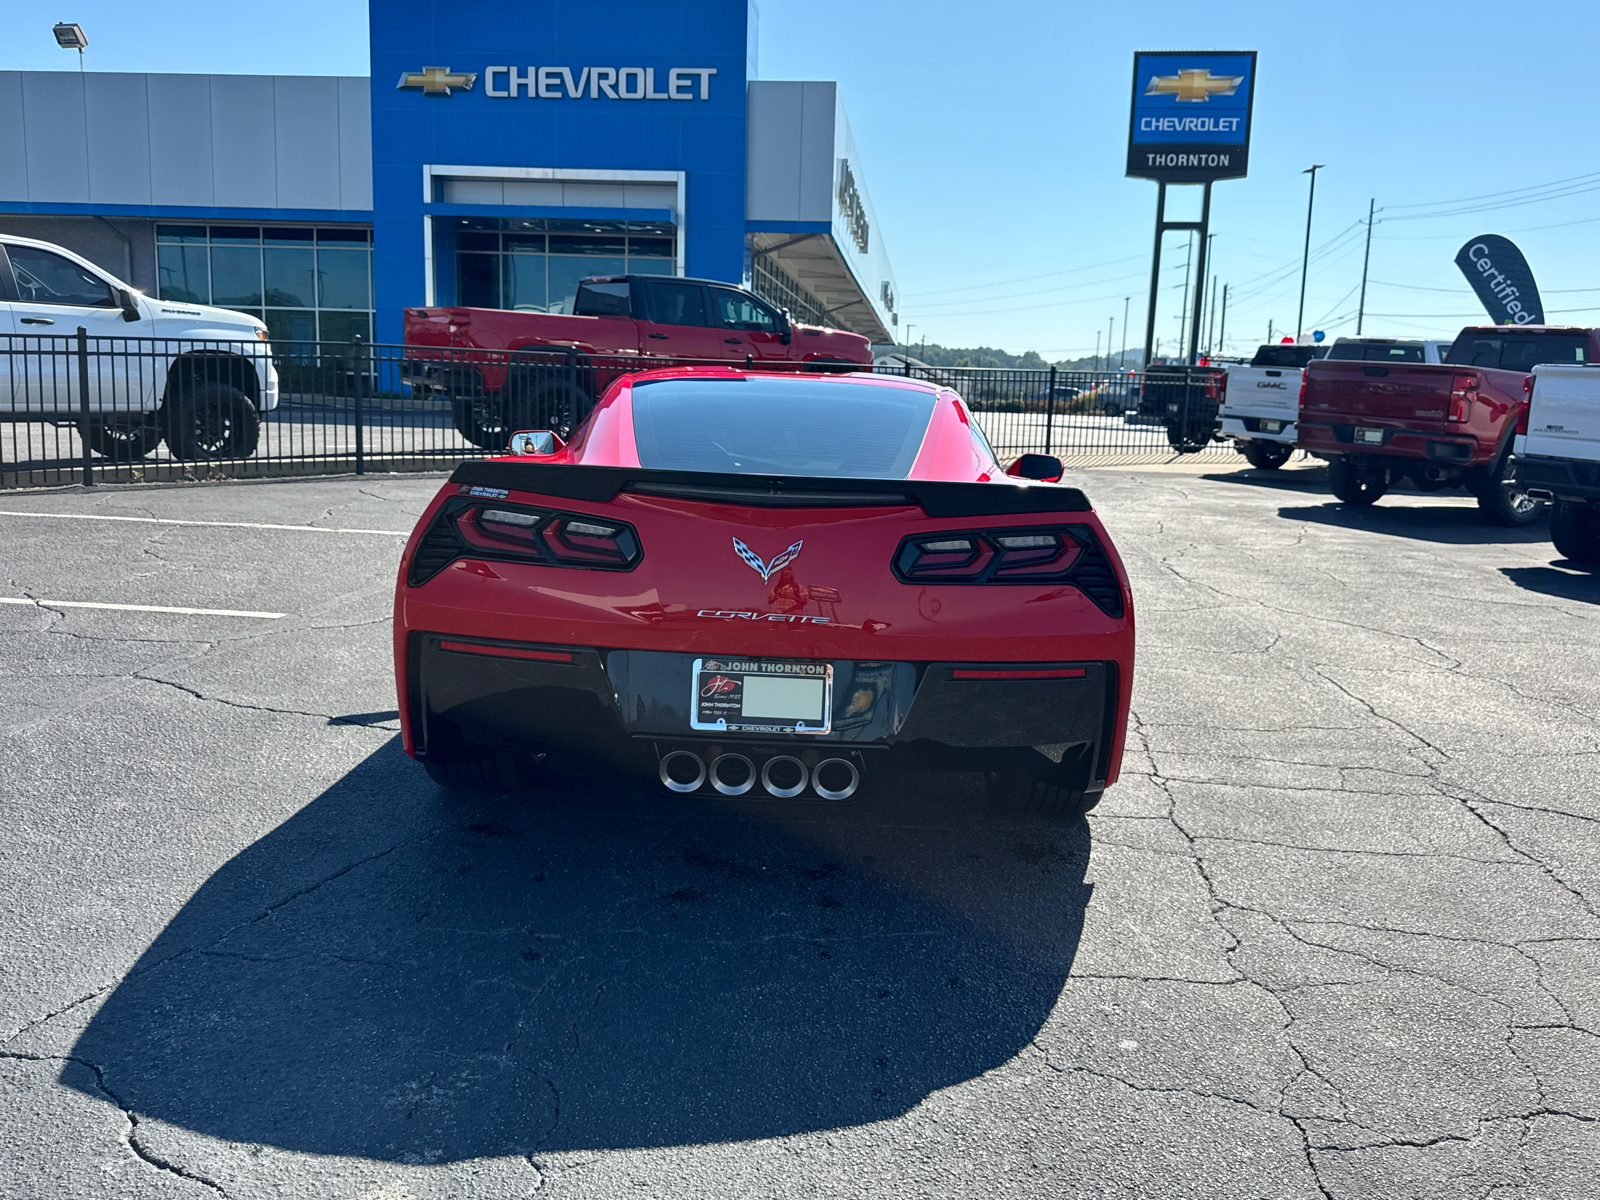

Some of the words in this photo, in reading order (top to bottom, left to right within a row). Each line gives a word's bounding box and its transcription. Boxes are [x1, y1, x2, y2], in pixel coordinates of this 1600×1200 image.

[485, 66, 717, 100] CHEVROLET
[1140, 117, 1240, 132] CHEVROLET
[1147, 153, 1230, 167] THORNTON
[1468, 243, 1536, 325] Certified
[161, 308, 202, 316] SILVERADO
[1257, 381, 1288, 390] GMC
[697, 609, 830, 625] CORVETTE
[726, 662, 758, 672] JOHN
[760, 663, 825, 674] THORNTON
